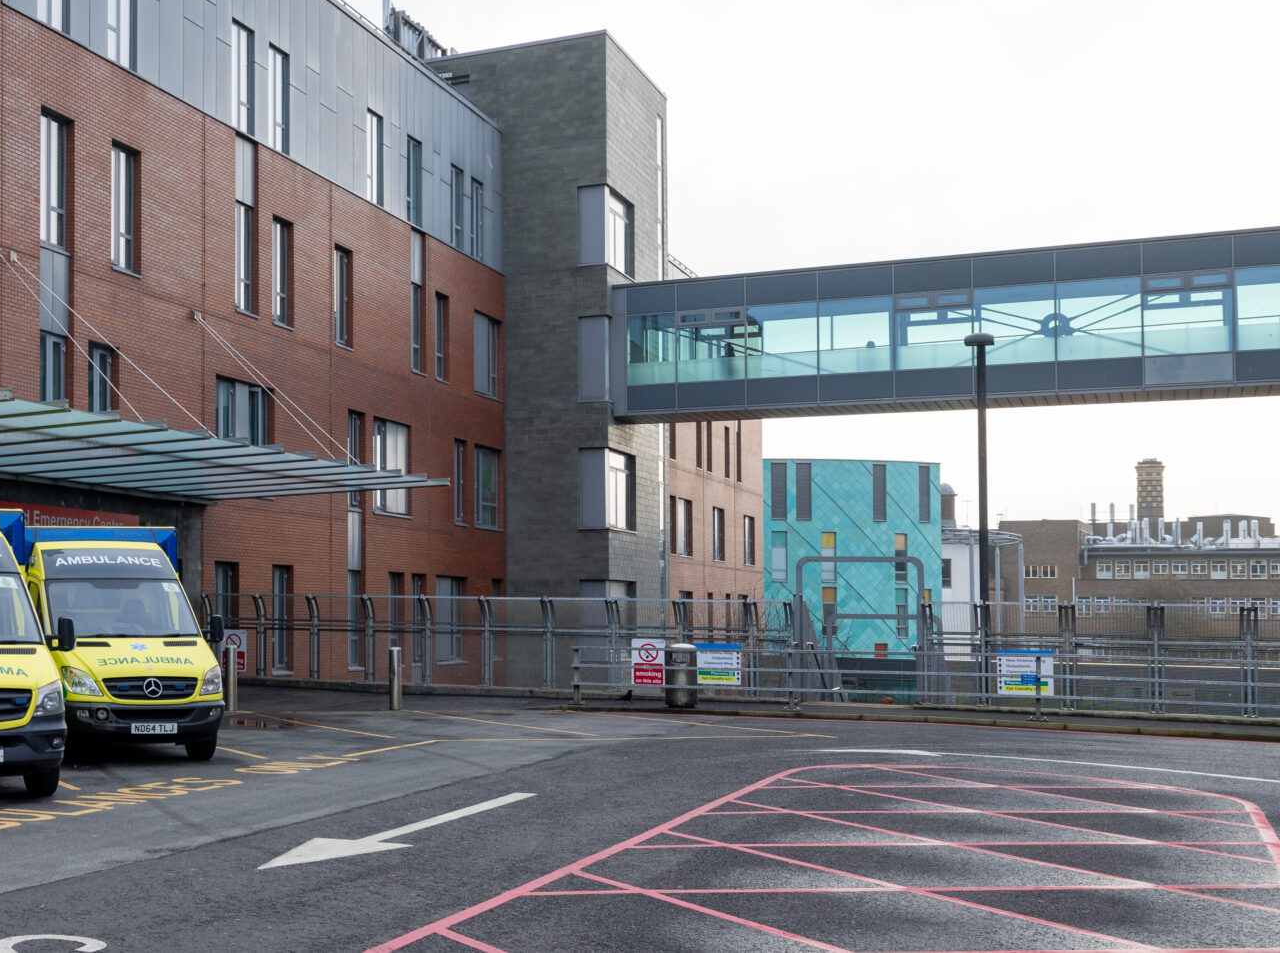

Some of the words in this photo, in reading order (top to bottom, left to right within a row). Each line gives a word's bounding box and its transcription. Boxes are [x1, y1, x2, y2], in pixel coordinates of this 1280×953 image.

[55, 556, 163, 567] AMBULANCE
[635, 670, 662, 678] smoking
[134, 724, 156, 733] ND64
[158, 724, 175, 733] TLJ
[233, 754, 359, 775] ONLY
